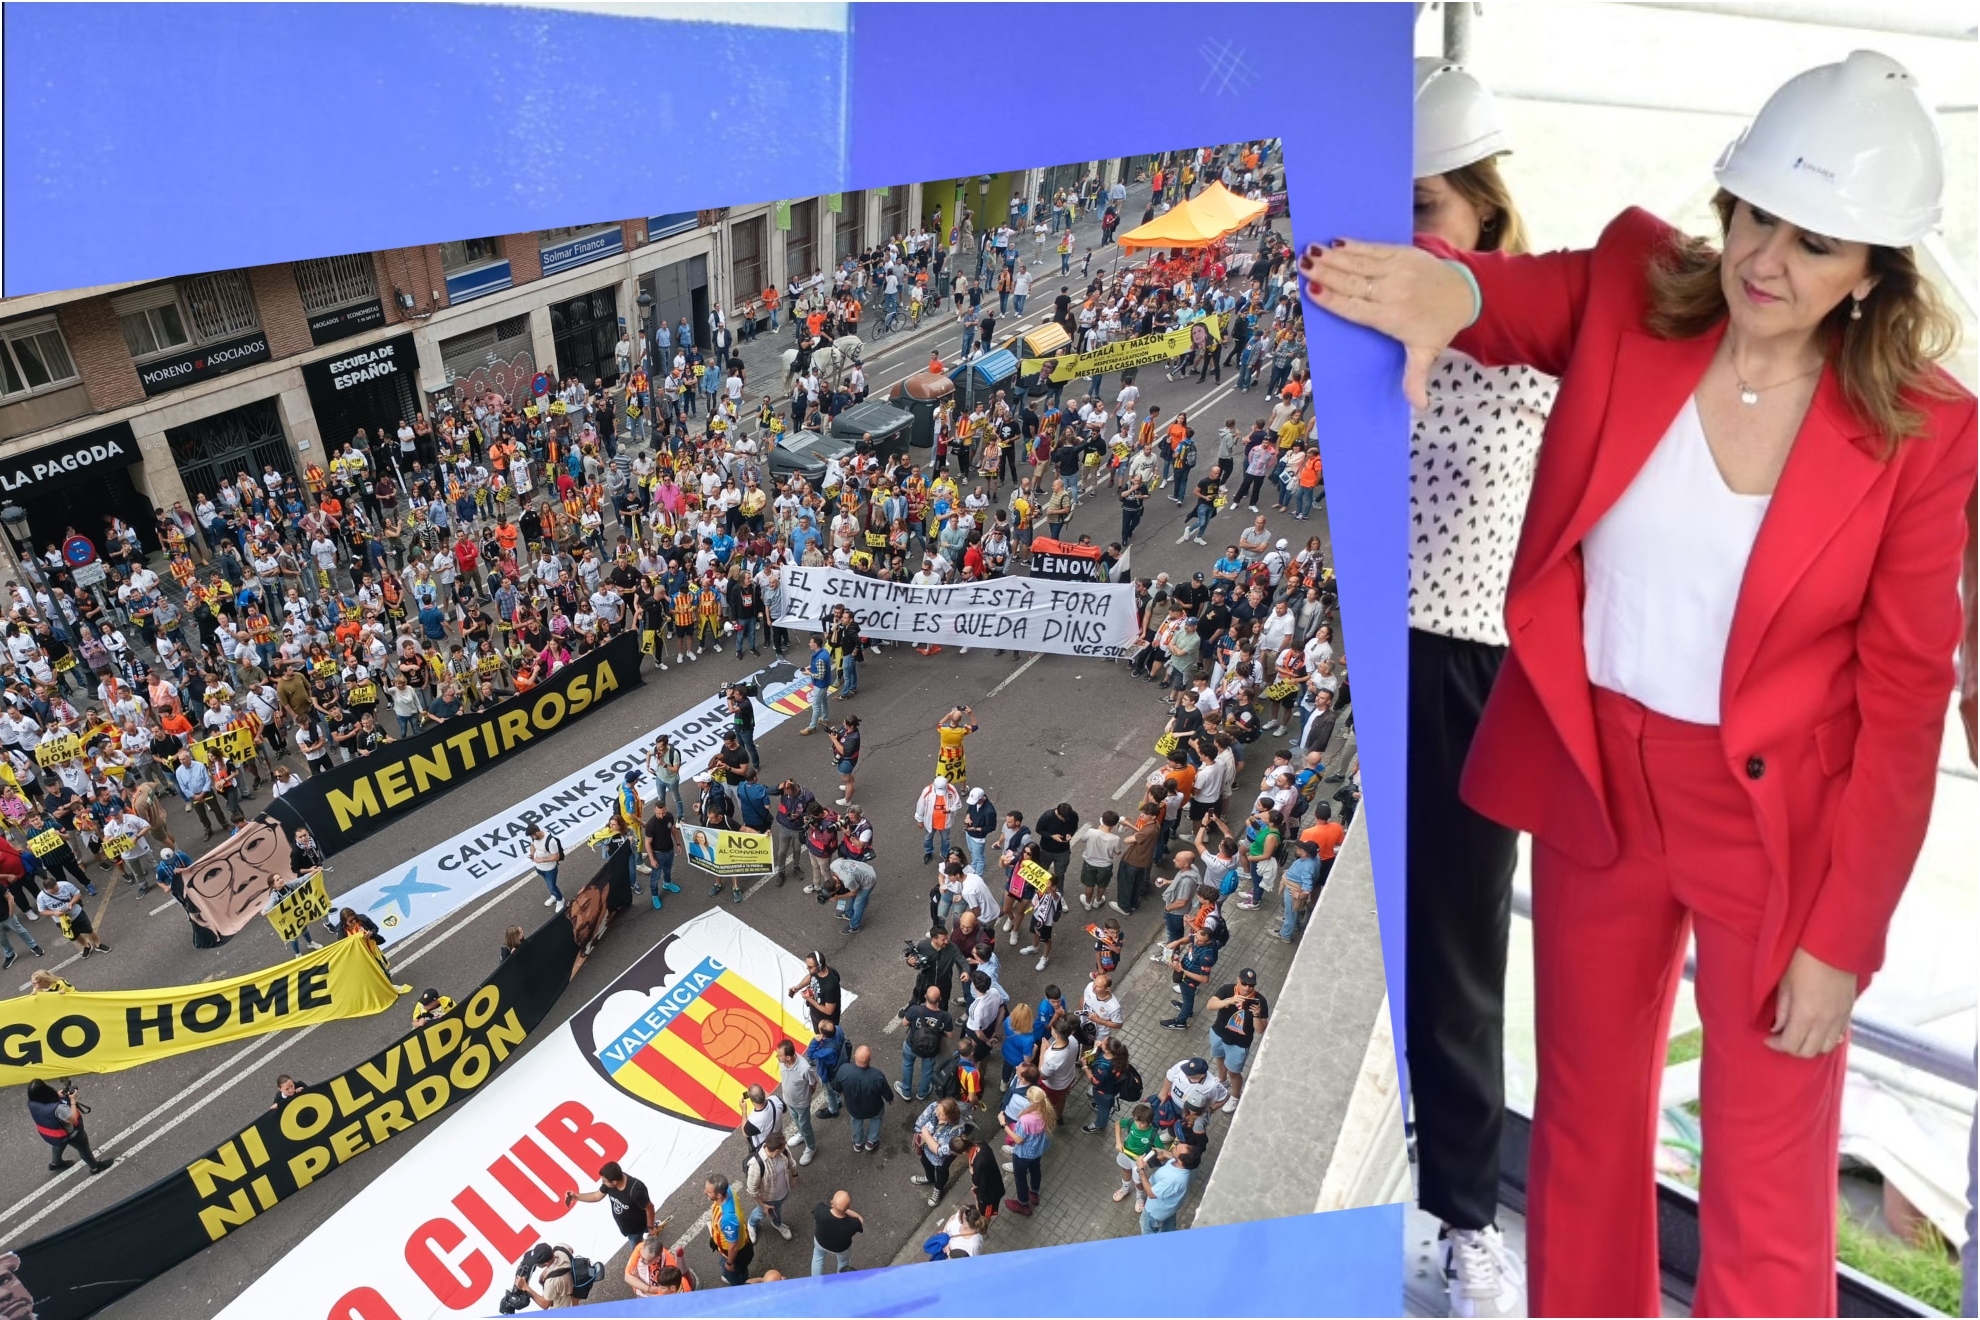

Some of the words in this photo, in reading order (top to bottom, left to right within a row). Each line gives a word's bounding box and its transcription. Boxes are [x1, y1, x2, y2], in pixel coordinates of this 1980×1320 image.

[543, 249, 573, 264] Solmar
[574, 239, 605, 255] Finance
[312, 317, 340, 330] ABOGADOS
[346, 305, 380, 320] ECONOMISTAS
[1120, 343, 1126, 351] Y
[1130, 334, 1164, 349] MAZÓN
[143, 361, 193, 386] MORENO
[207, 340, 265, 367] ASOCIADOS
[329, 351, 379, 374] ESCUELA
[378, 345, 395, 362] DE
[1075, 365, 1114, 378] MESTALLA
[1114, 360, 1135, 370] CASA
[1136, 352, 1168, 366] NOSTRA
[334, 360, 398, 390] ESPAÑOL
[0, 470, 33, 491] LA
[32, 440, 124, 481] PAGODA
[788, 570, 811, 592] EL
[823, 578, 959, 606] SENTIMENT
[969, 583, 1035, 610] ESTÀ
[1051, 590, 1112, 617] FORA
[786, 598, 810, 621] EL
[912, 612, 942, 633] ES
[954, 613, 1028, 639] QUEDA
[353, 688, 368, 696] LIM
[1269, 681, 1285, 692] LIM
[1272, 685, 1296, 701] HOME
[41, 734, 68, 749] LIM
[50, 744, 64, 753] GO
[202, 729, 238, 751] LIM
[326, 659, 619, 832] MENTIROSA
[41, 747, 81, 765] HOME
[945, 761, 962, 771] GO
[438, 779, 598, 871] CAIXABANK
[594, 704, 733, 784] SOLUIONE
[466, 858, 502, 879] EL
[498, 794, 617, 859] VAENCIA
[682, 722, 735, 758] MUER
[33, 833, 52, 845] LIM
[35, 839, 62, 856] HOME
[728, 836, 759, 849] NO
[1019, 868, 1046, 890] HOME
[1026, 861, 1045, 878] LIM
[280, 880, 313, 915] LIM
[293, 899, 312, 918] GO
[284, 894, 328, 940] HOME
[0, 1014, 101, 1067] GO
[125, 962, 333, 1048] HOME
[605, 972, 713, 1062] VALENCIA
[187, 1125, 271, 1199] NI
[279, 984, 500, 1142] OLVIDO
[198, 1174, 279, 1241] NI
[287, 1007, 527, 1190] PERDÓN
[404, 1100, 629, 1311] CLUB
